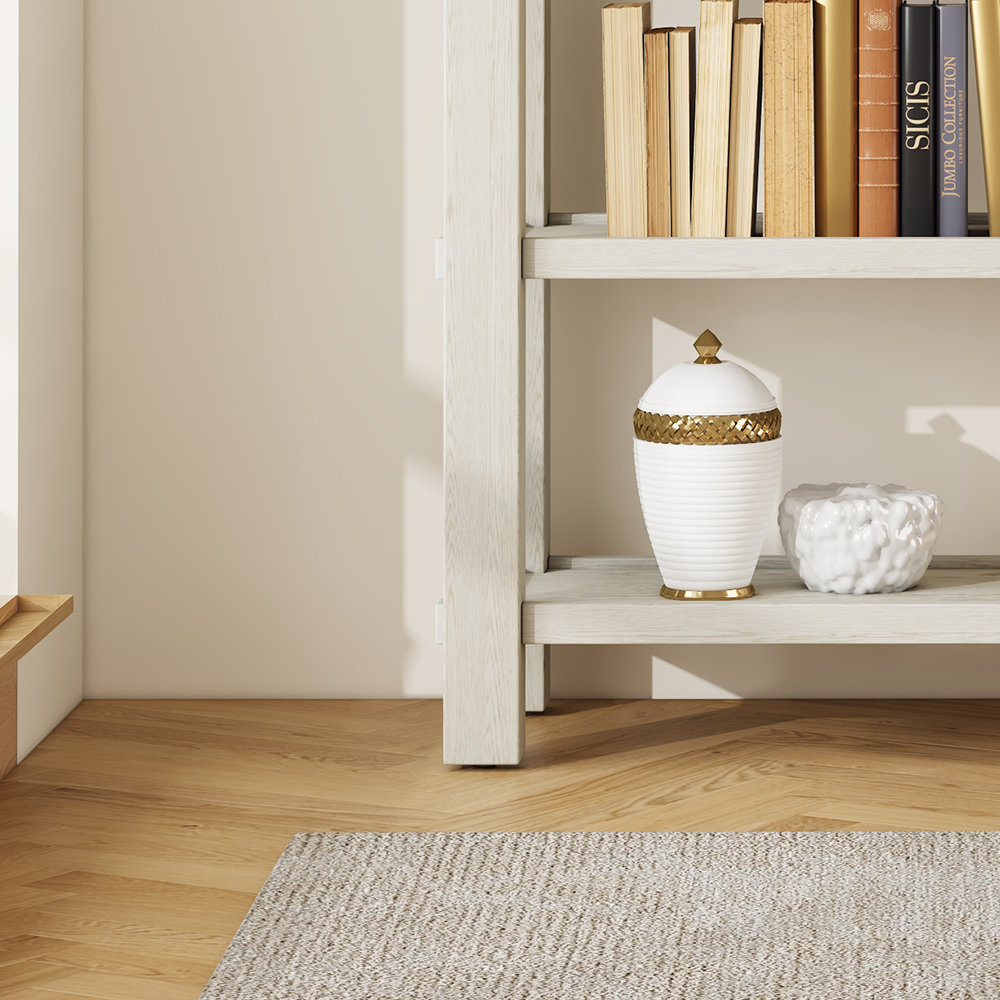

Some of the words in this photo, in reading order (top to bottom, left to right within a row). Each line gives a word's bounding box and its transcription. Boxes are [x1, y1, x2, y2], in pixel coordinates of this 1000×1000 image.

[905, 81, 930, 150] SICIS
[941, 56, 956, 145] COLLECTION
[941, 149, 960, 198] JUMBO
